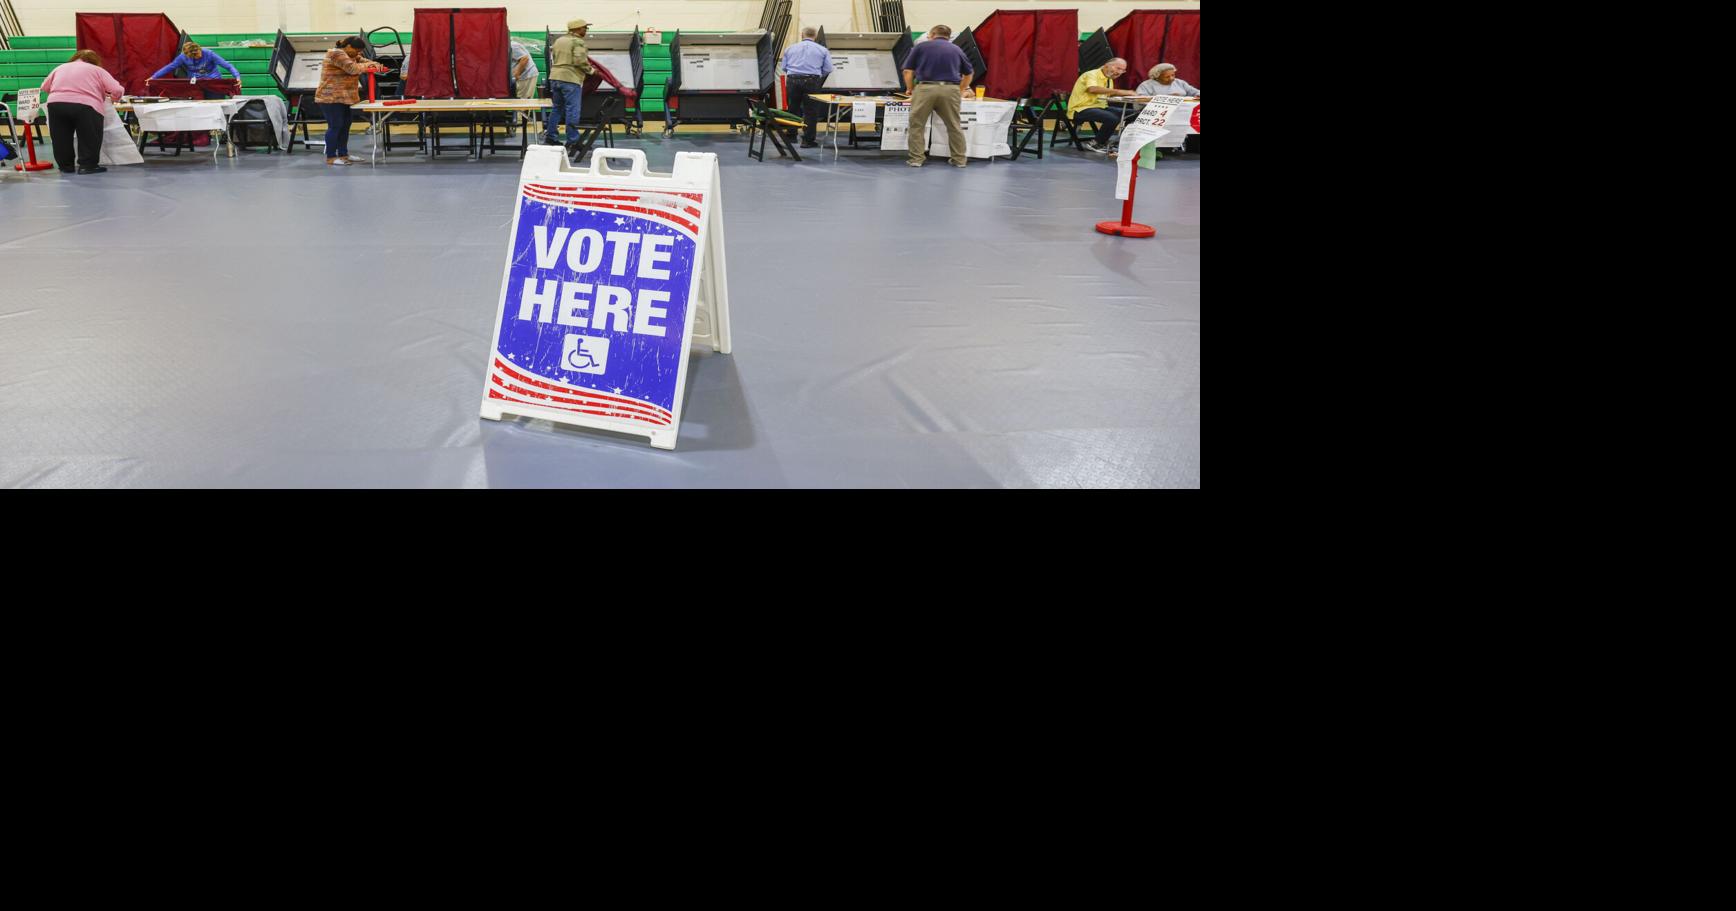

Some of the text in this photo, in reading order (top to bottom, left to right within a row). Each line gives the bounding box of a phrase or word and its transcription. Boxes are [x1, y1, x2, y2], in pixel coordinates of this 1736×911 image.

[1142, 109, 1158, 117] WARD
[1152, 118, 1166, 126] 22
[533, 225, 675, 280] VOTE
[518, 277, 671, 337] HERE
